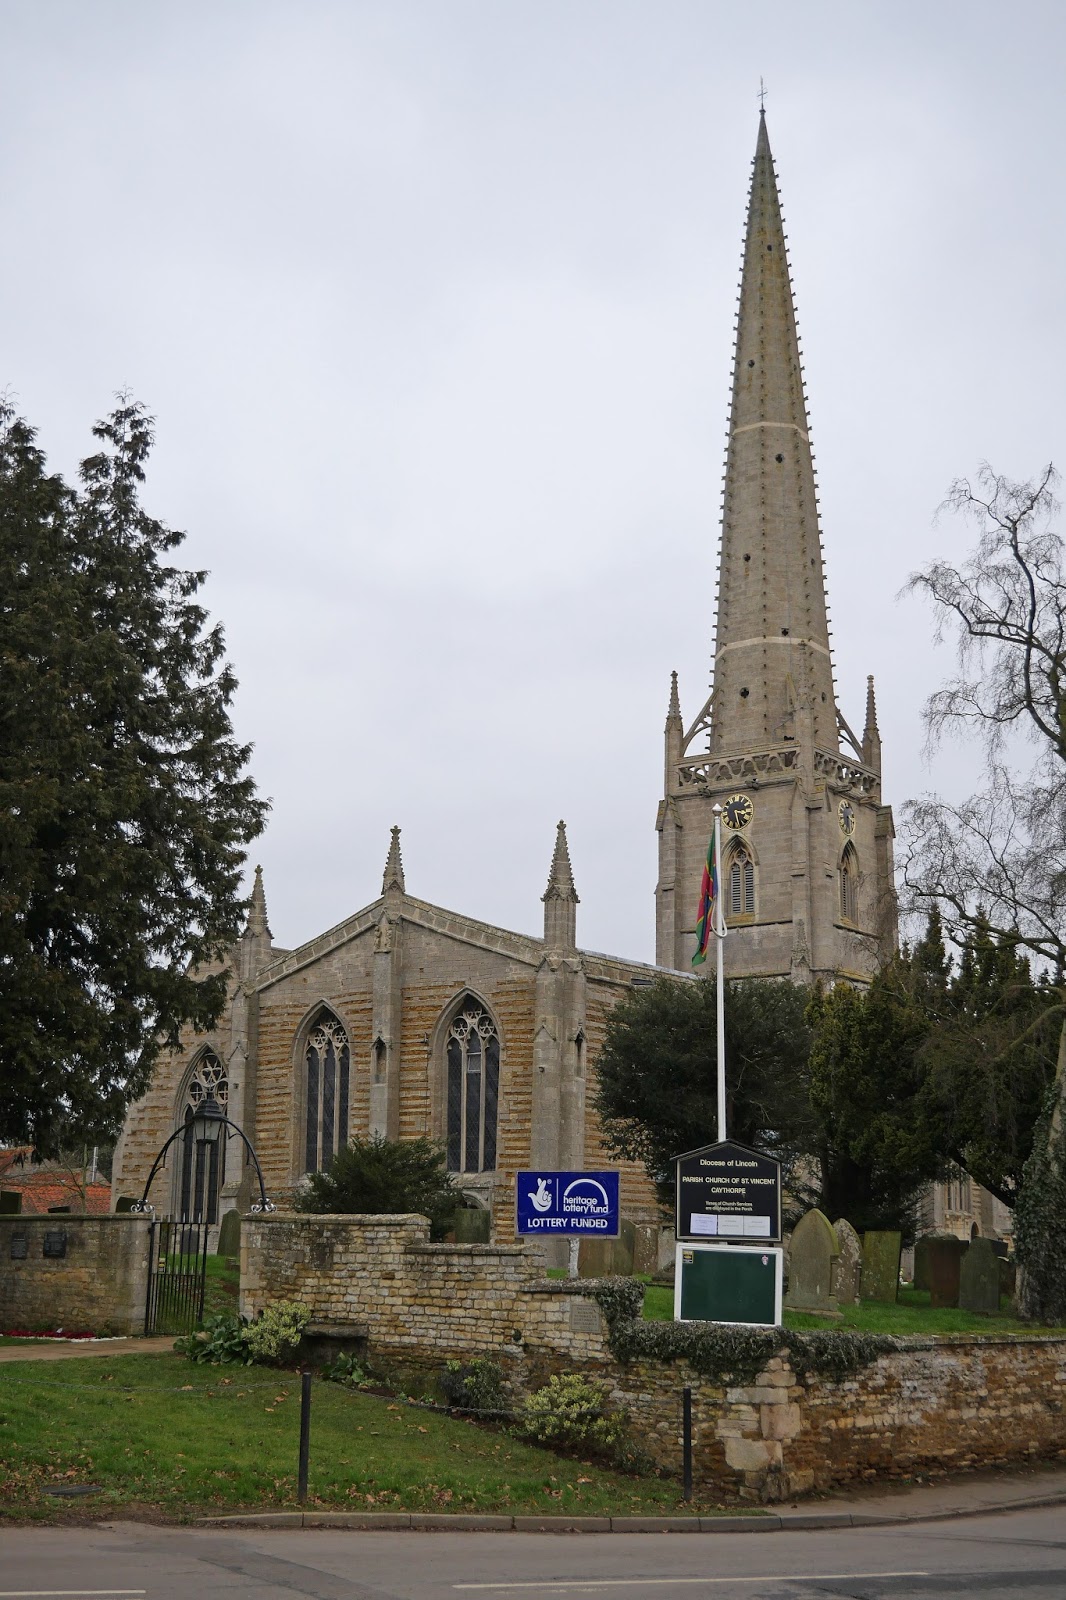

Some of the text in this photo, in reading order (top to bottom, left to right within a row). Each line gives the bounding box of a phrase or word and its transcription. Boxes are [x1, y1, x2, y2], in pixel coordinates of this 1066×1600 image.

[564, 1196, 598, 1206] heritage
[564, 1204, 588, 1214] lottery
[528, 1218, 608, 1228] LOTTERY FUNDED
